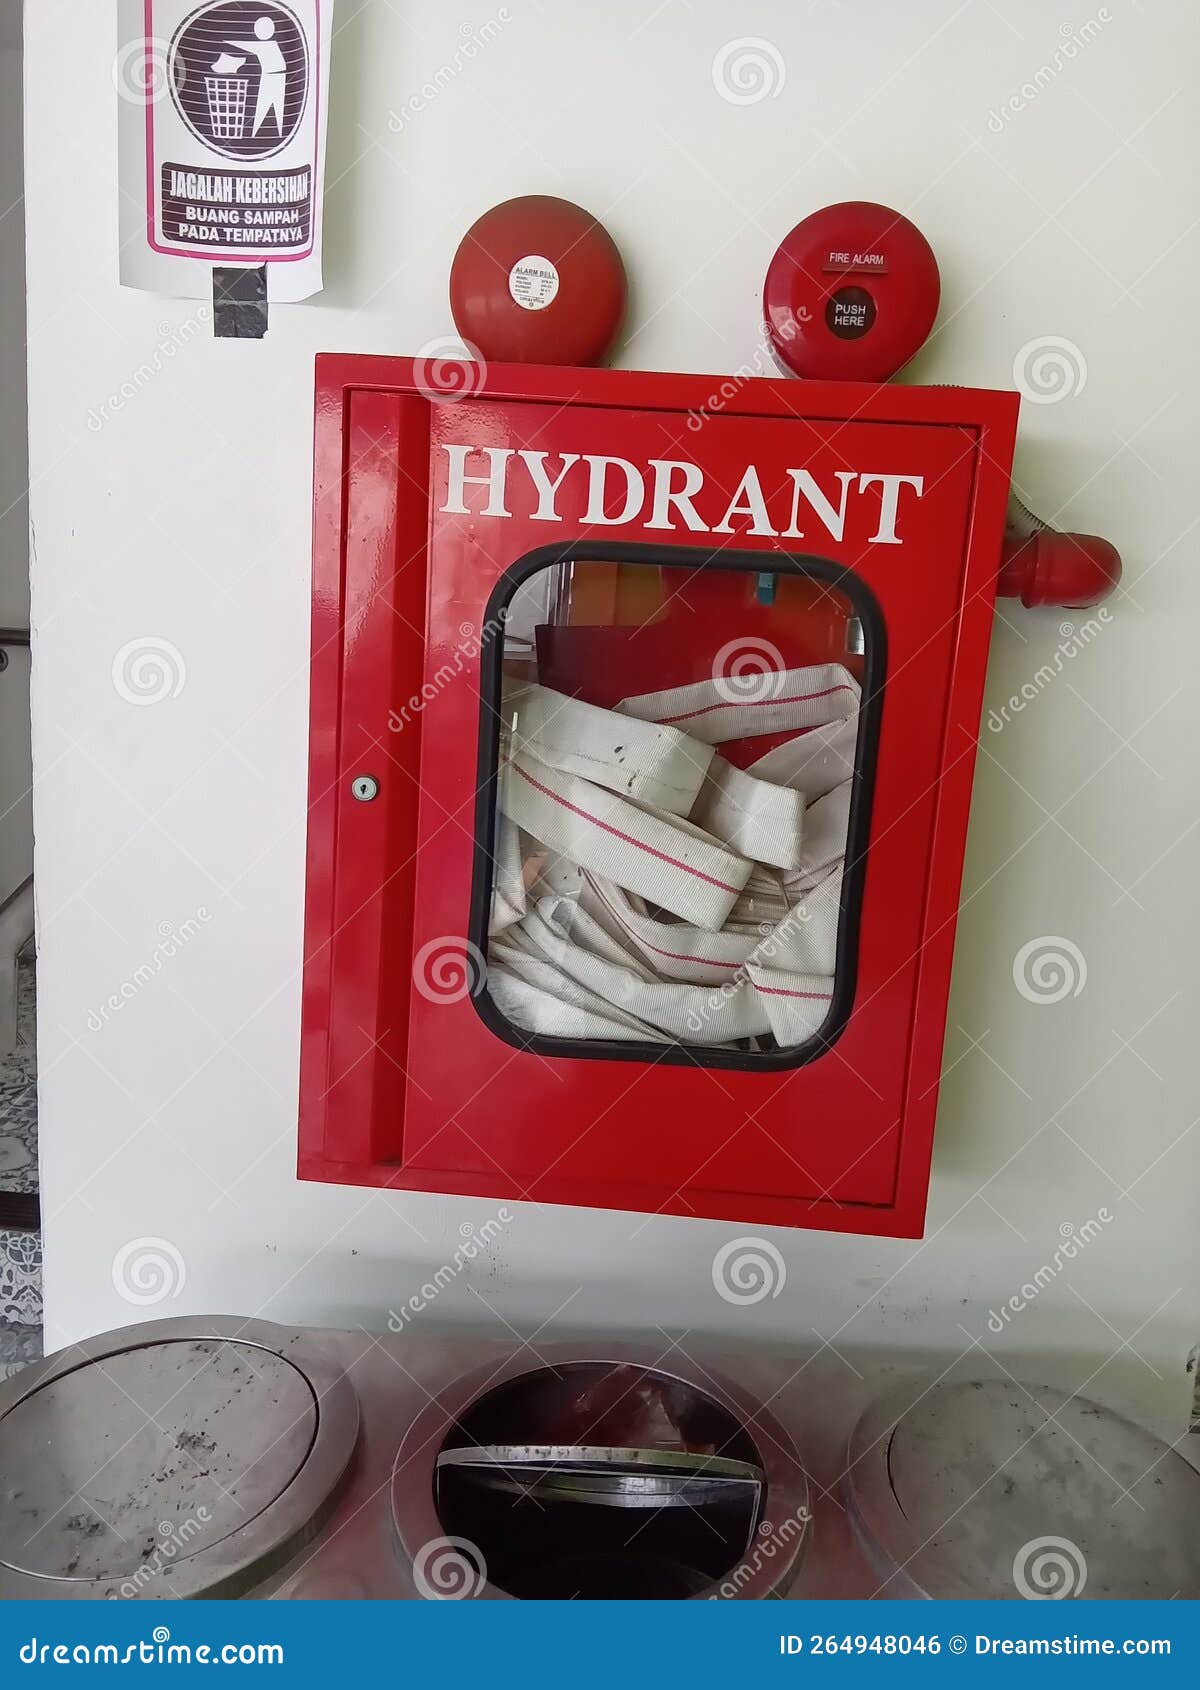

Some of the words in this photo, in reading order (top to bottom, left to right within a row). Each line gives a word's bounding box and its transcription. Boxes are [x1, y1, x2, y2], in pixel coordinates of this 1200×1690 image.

[170, 171, 234, 203] JAGALAH
[235, 171, 309, 203] KEBERSIHAN
[185, 206, 240, 225] BUANG
[244, 209, 299, 225] SAMPAH
[178, 223, 219, 241] PADA
[223, 226, 303, 243] TEMPATNYA
[829, 252, 850, 264] FIRE
[852, 253, 884, 265] ALARM
[515, 267, 539, 276] ALARM
[835, 304, 866, 315] PUSH
[834, 315, 865, 327] HERE
[439, 443, 925, 545] HYDRANT
